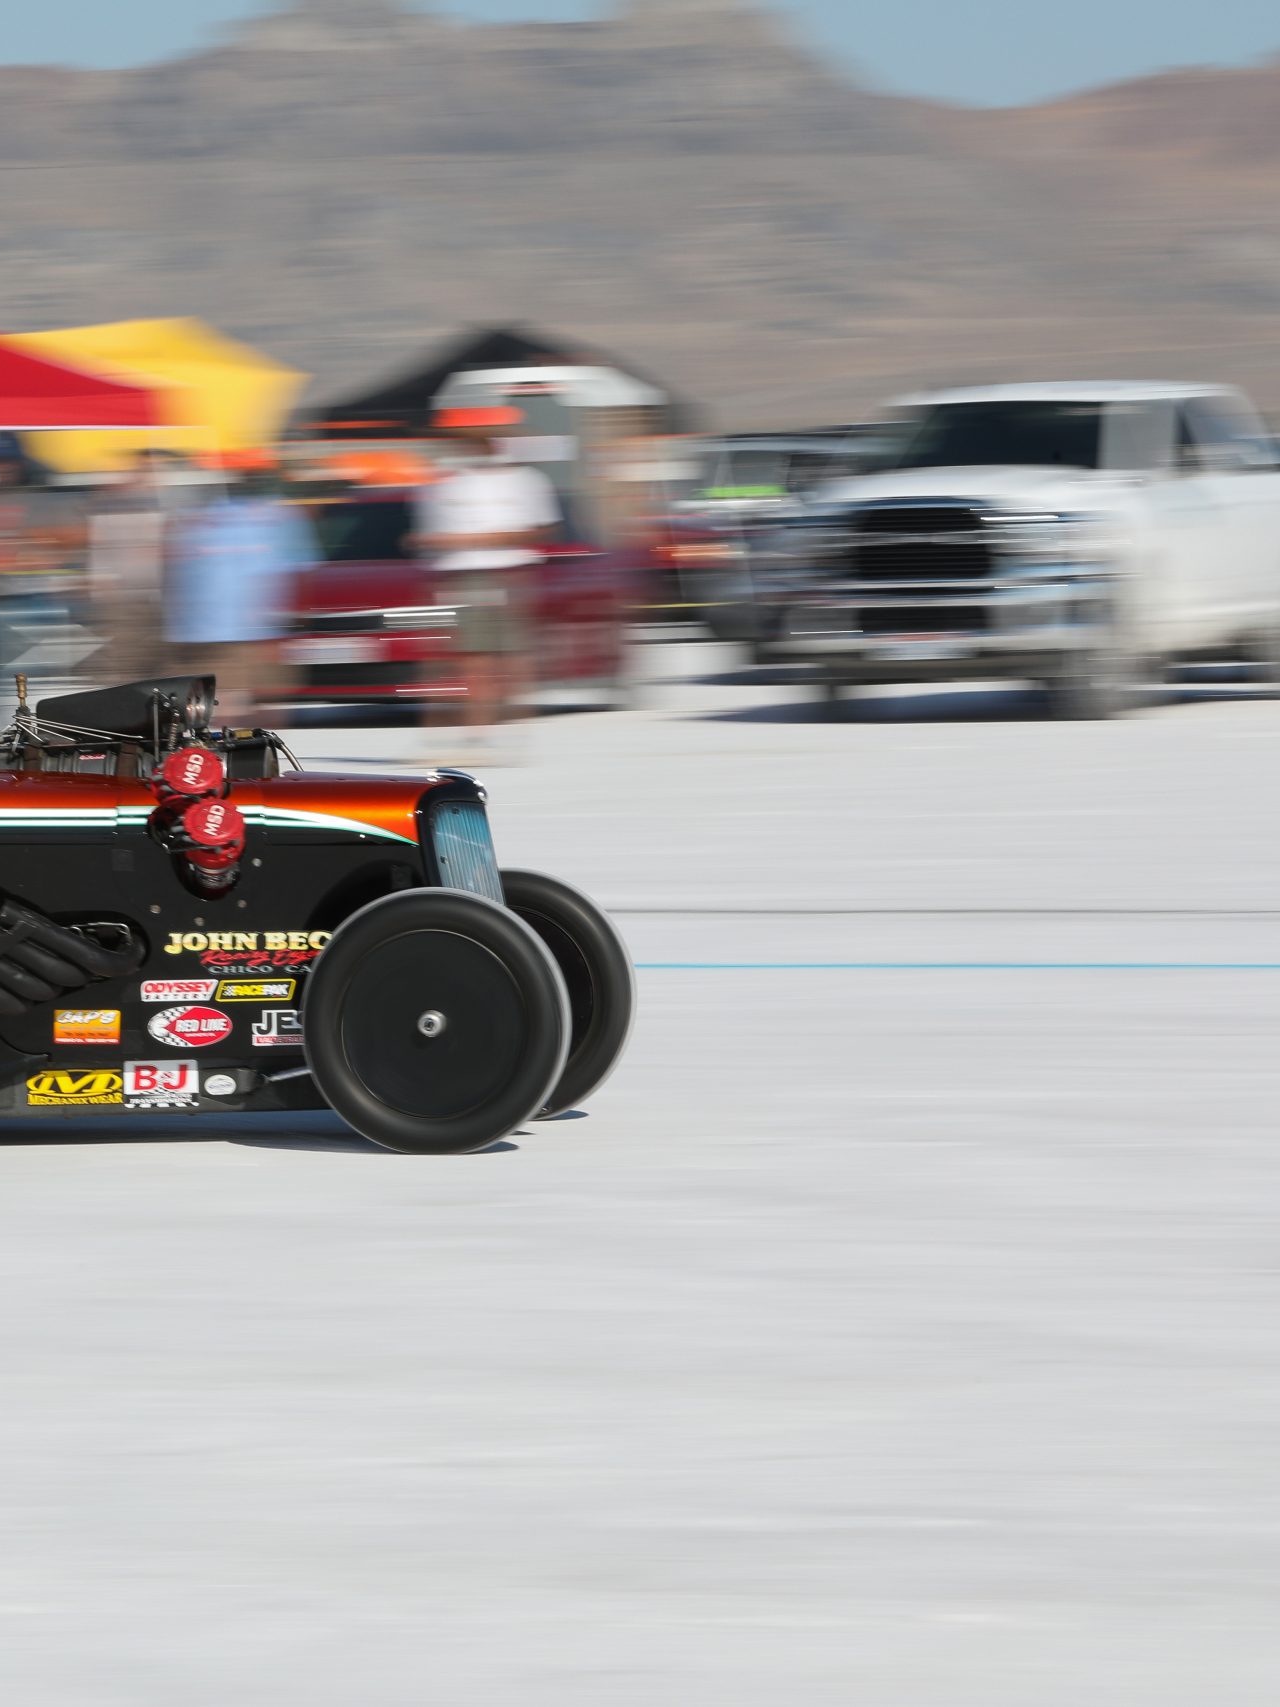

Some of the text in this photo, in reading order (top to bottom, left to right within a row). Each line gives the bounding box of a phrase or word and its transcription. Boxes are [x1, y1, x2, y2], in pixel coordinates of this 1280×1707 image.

[182, 753, 204, 785] MSD
[203, 804, 225, 836] MSD
[163, 931, 333, 955] JOHN BEC
[208, 965, 313, 975] CHICO CA
[144, 982, 213, 993] ODYSSEY
[175, 1018, 228, 1033] RED LINE
[252, 1009, 304, 1036] JE
